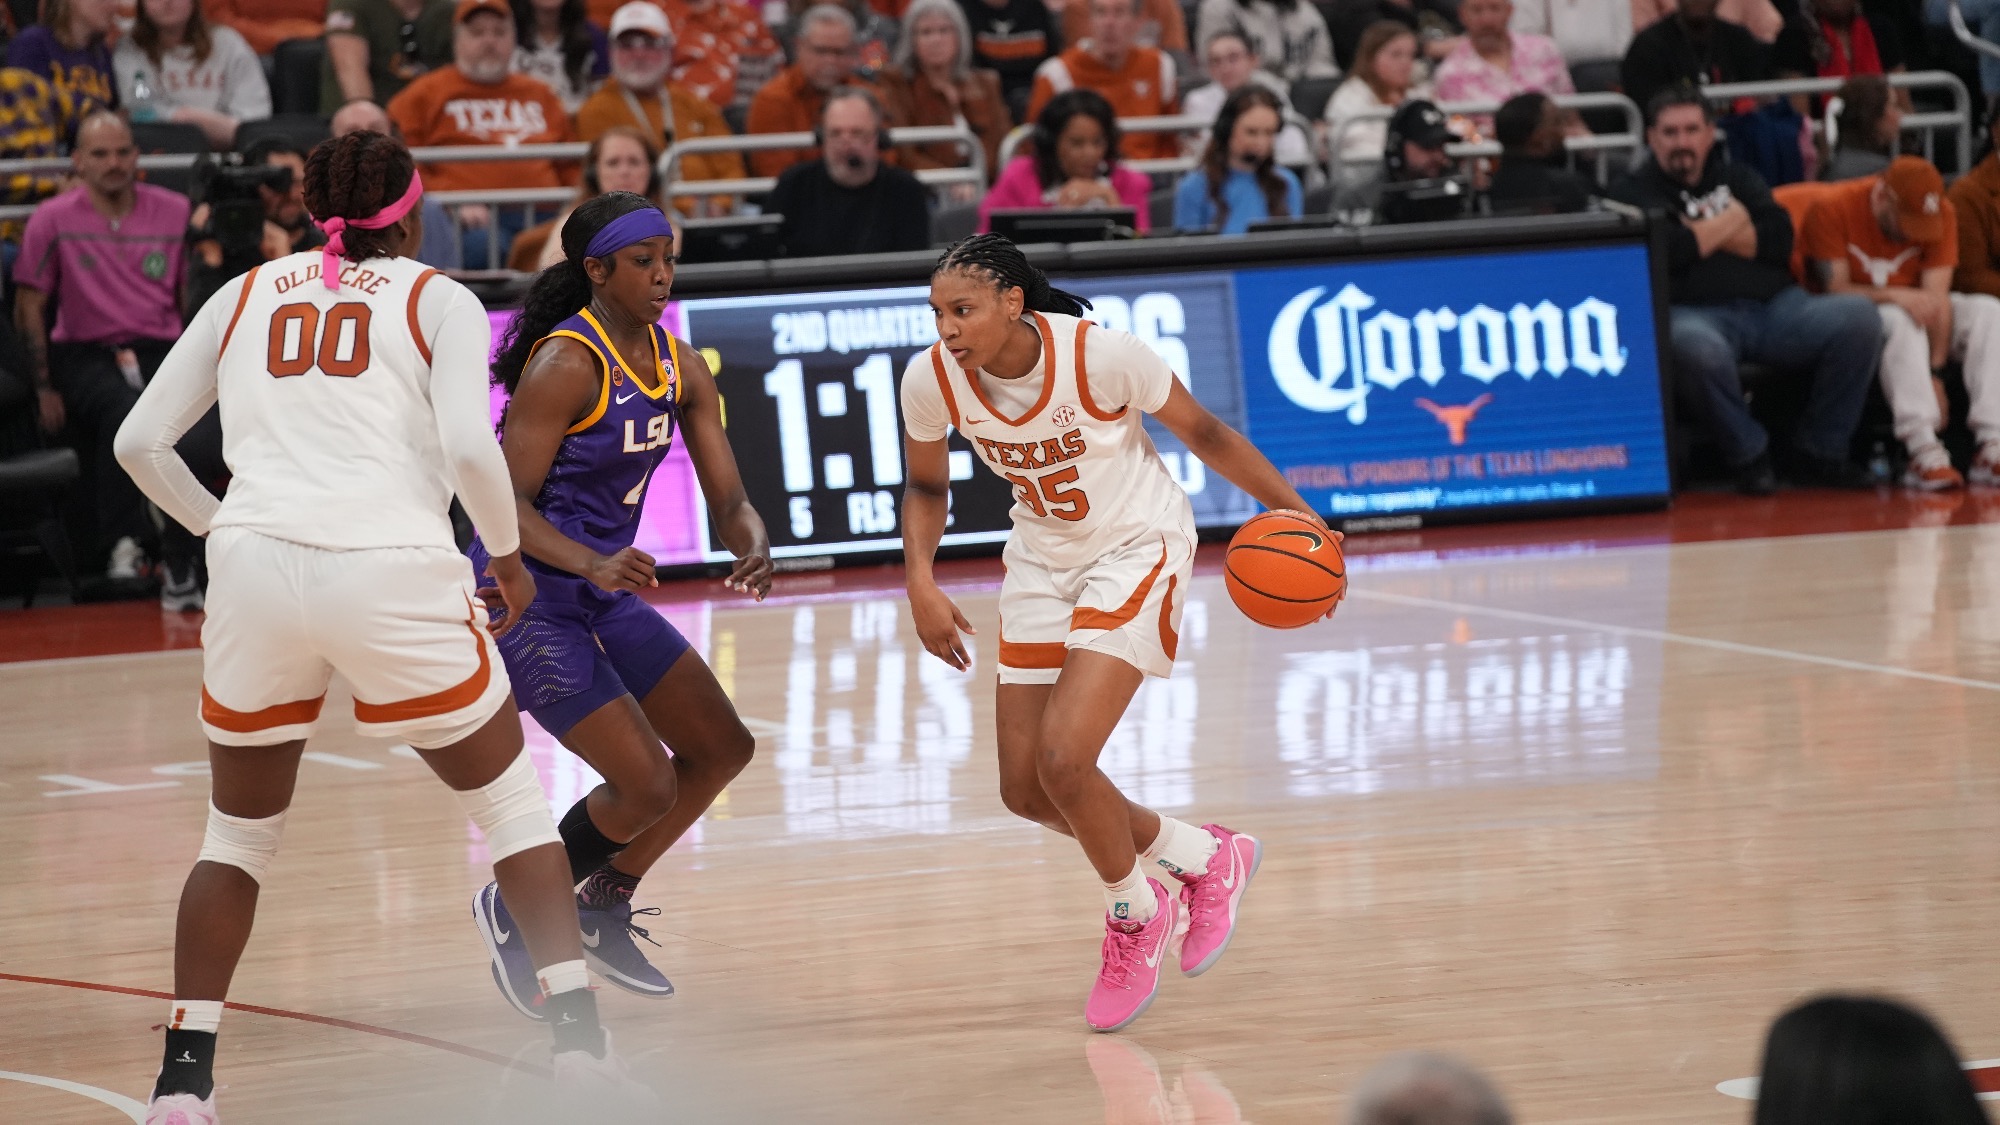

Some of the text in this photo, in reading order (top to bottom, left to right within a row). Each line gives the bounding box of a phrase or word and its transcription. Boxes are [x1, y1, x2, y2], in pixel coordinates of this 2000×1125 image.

[444, 98, 547, 141] TEXAS
[274, 264, 391, 295] OLDCRE
[267, 302, 372, 378] 00
[771, 311, 828, 354] 2ND
[1267, 282, 1628, 425] Corona
[763, 352, 973, 492] 1:1
[975, 428, 1086, 469] TEXAS
[789, 496, 814, 538] 5
[847, 490, 896, 534] FLS
[1005, 465, 1090, 521] 35
